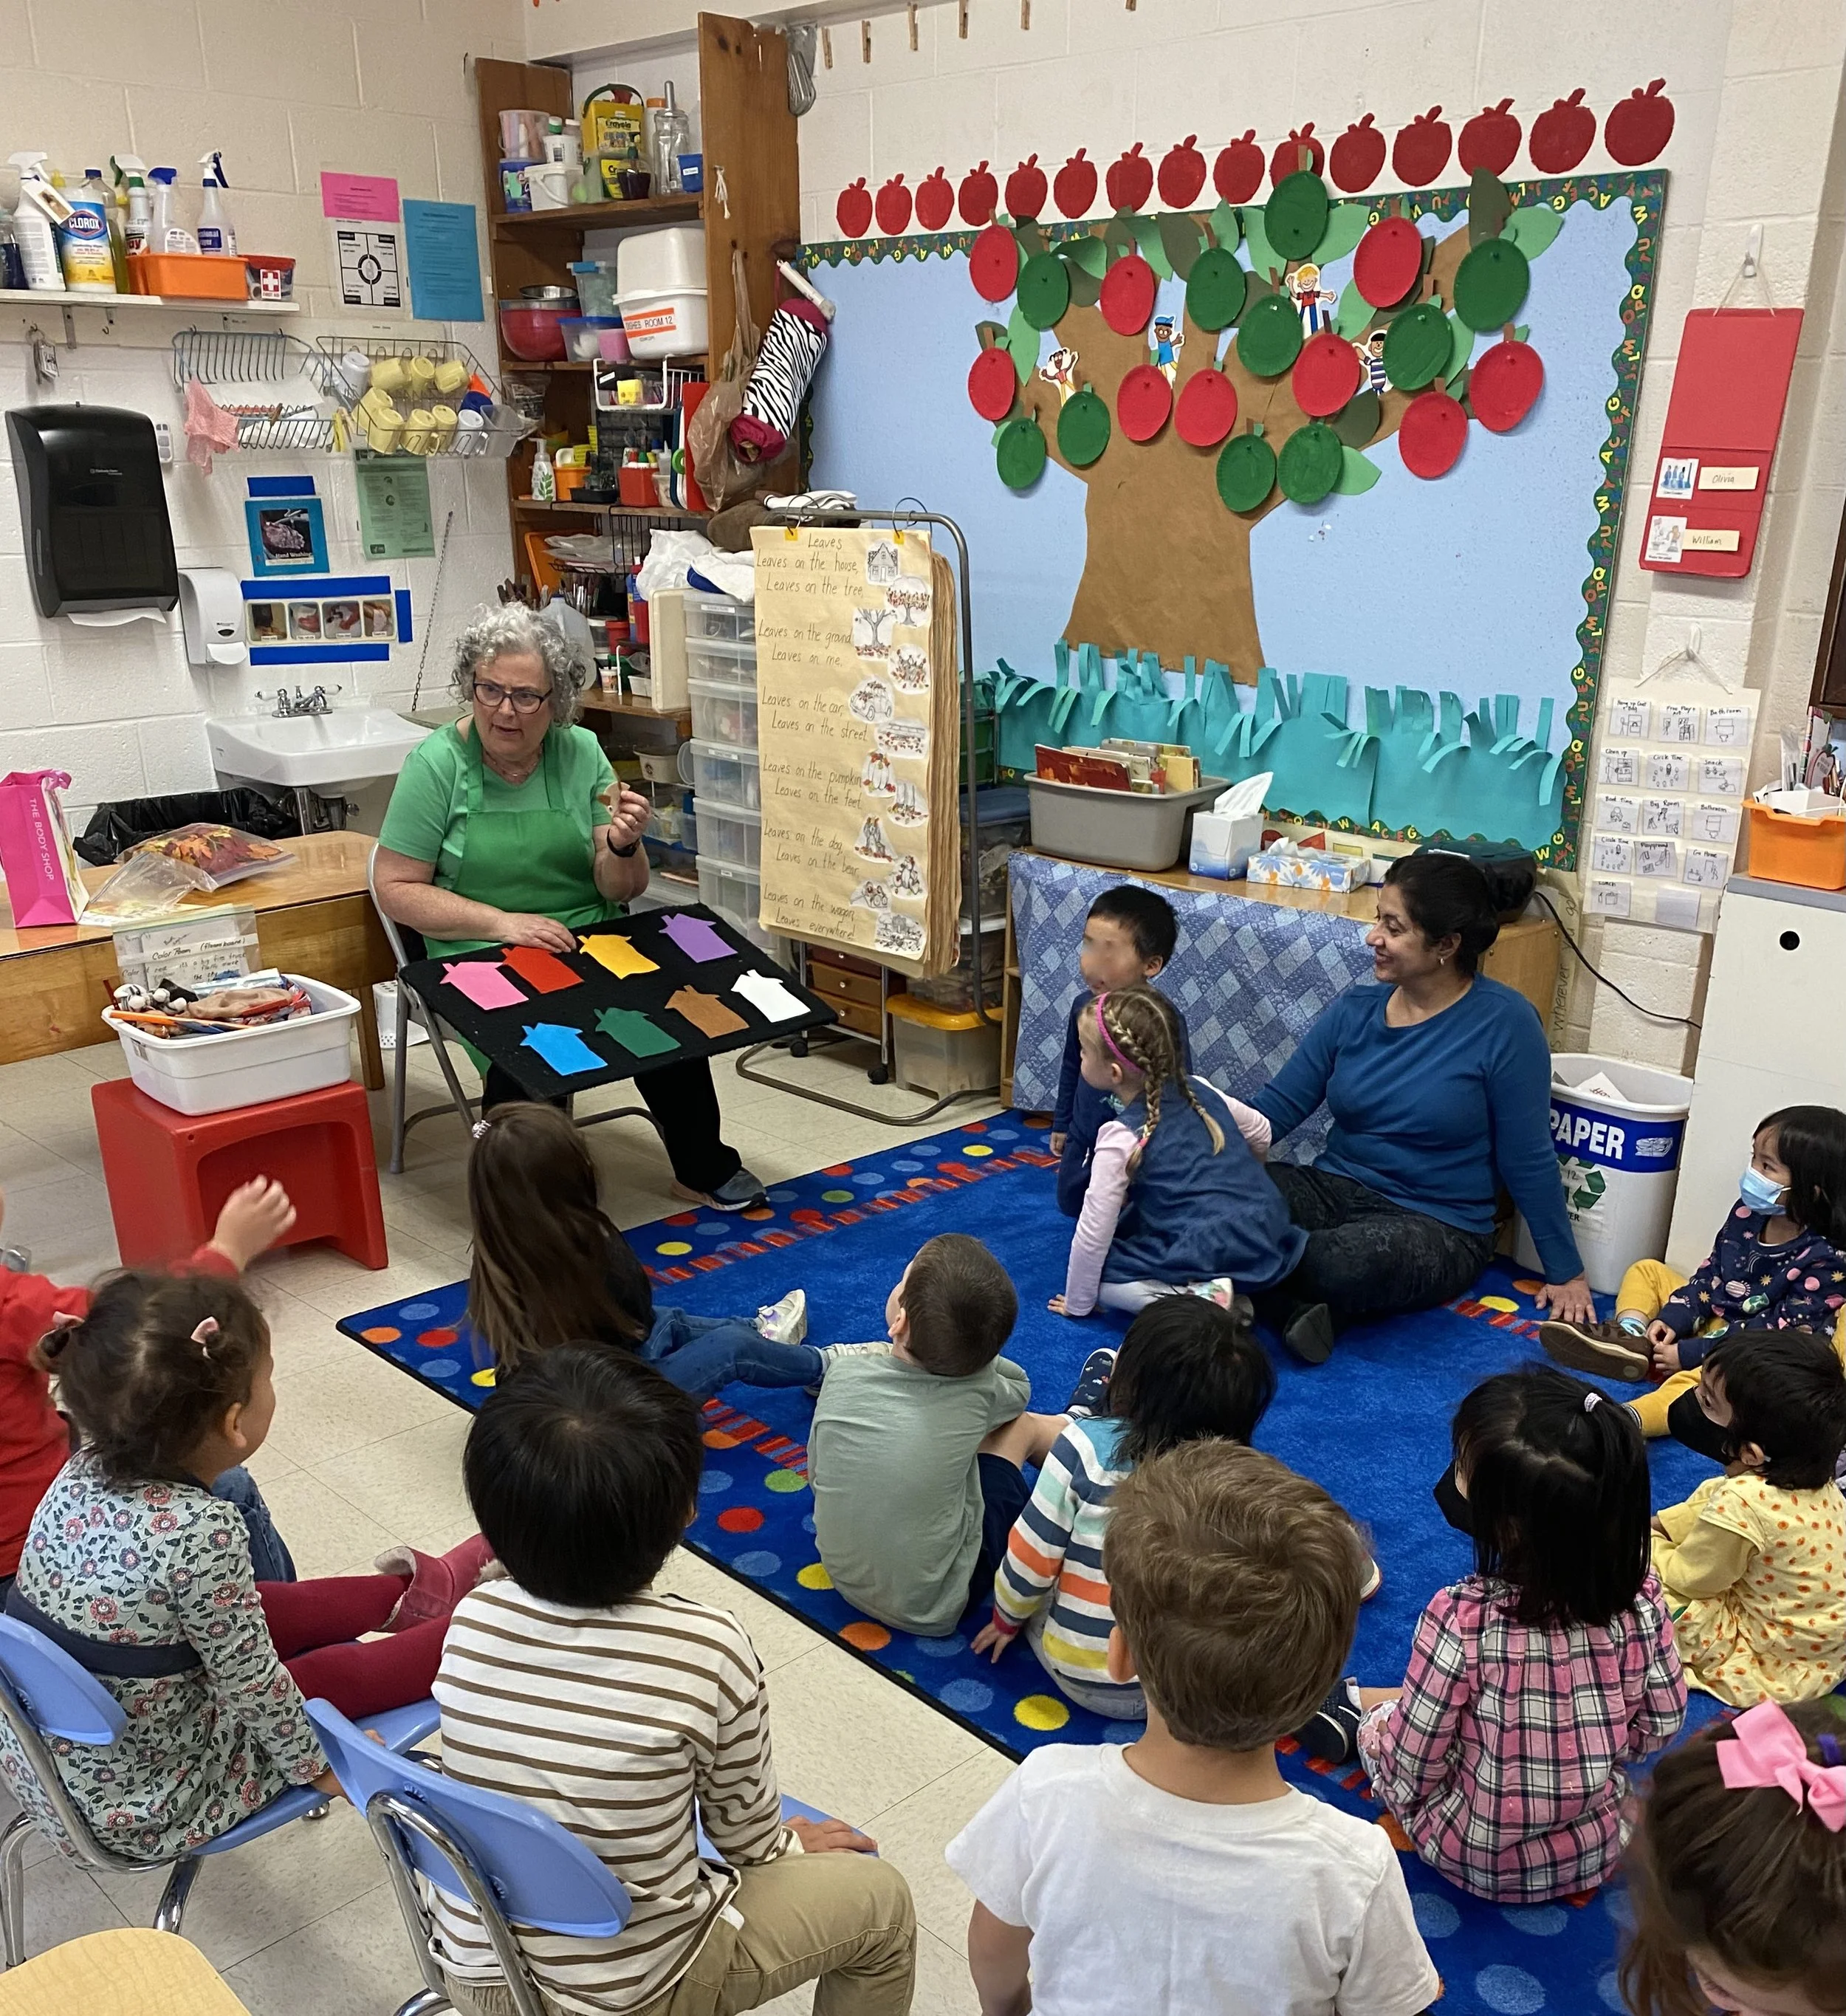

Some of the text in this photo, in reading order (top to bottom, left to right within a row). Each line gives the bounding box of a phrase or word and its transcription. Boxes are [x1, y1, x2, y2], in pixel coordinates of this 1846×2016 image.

[605, 120, 631, 128] Crayola
[68, 218, 100, 229] CLOROX
[645, 318, 664, 327] ROOM
[665, 316, 673, 324] 12
[1712, 473, 1735, 483] Olivia
[809, 533, 842, 549] Leaves
[1692, 535, 1722, 545] William
[757, 549, 858, 574] Leaves on the house,
[766, 575, 800, 592] Leaves
[806, 582, 816, 591] on
[823, 577, 837, 594] the
[758, 620, 787, 637] Leaves
[794, 630, 803, 640] on
[808, 625, 820, 642] the
[772, 644, 800, 663] Leaves
[810, 654, 820, 663] on
[762, 687, 845, 716] Leaves on the car,
[772, 711, 798, 729] Leaves
[806, 721, 814, 733] on
[821, 719, 834, 736] the
[763, 755, 790, 774] Leaves
[796, 764, 806, 775] on
[809, 761, 823, 781] the
[775, 778, 802, 798] Leaves
[809, 792, 819, 802] on
[825, 786, 838, 804] the
[1701, 804, 1727, 812] Bathroom
[30, 798, 54, 880] THE BODY SHOP
[764, 818, 843, 855] Leaves on the dog,
[1641, 843, 1668, 851] Playground
[776, 844, 801, 865] Leaves
[808, 857, 817, 868] on
[823, 852, 836, 871] the
[764, 884, 788, 904] Leaves
[794, 896, 804, 908] on
[812, 892, 824, 911] the
[775, 908, 855, 941] Leaves everywhere!
[152, 951, 171, 960] Color
[122, 969, 140, 977] Color
[1551, 965, 1570, 1032] wherever
[1562, 928, 1576, 953] yu
[1551, 1108, 1625, 1161] PAPER
[1567, 1170, 1579, 1180] 12
[1568, 1212, 1579, 1221] ER
